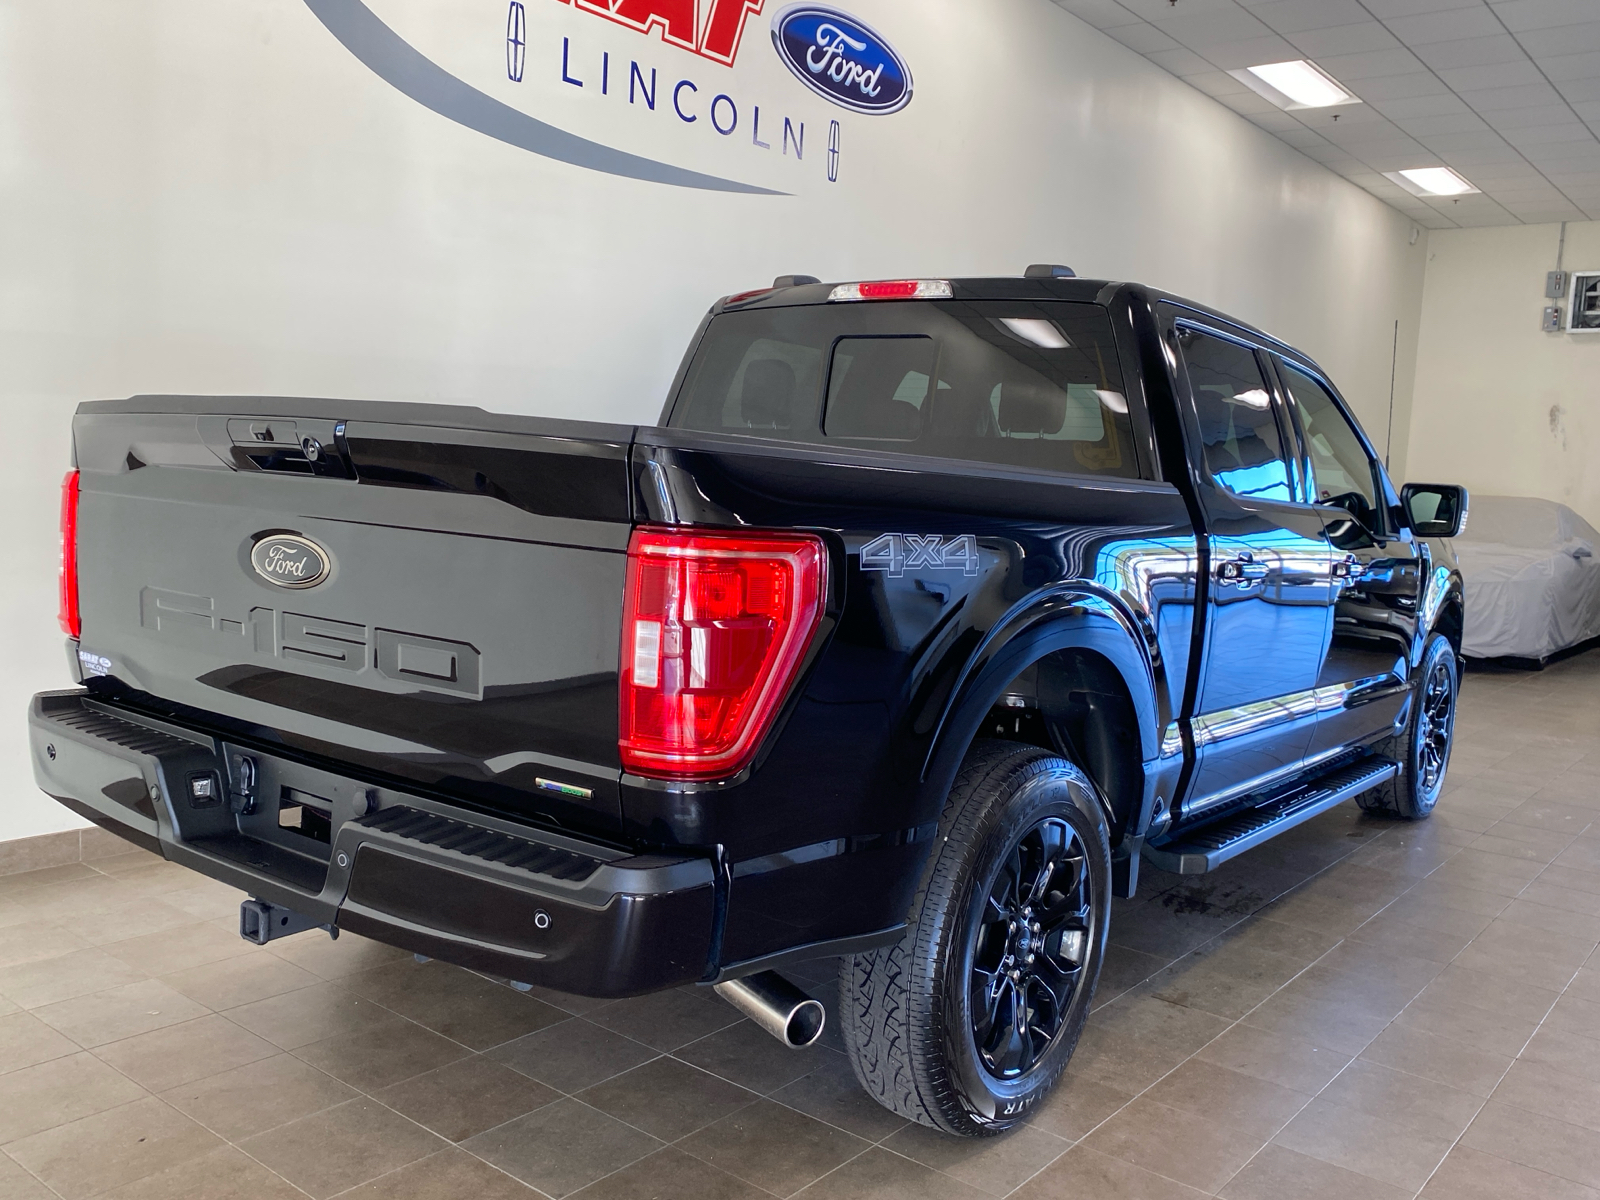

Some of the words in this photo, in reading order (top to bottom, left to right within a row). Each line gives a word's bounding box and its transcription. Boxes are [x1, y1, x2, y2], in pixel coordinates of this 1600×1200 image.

[561, 36, 804, 161] LINCOLN
[806, 23, 884, 97] Ford
[265, 545, 307, 577] Ford
[140, 585, 483, 701] F-150
